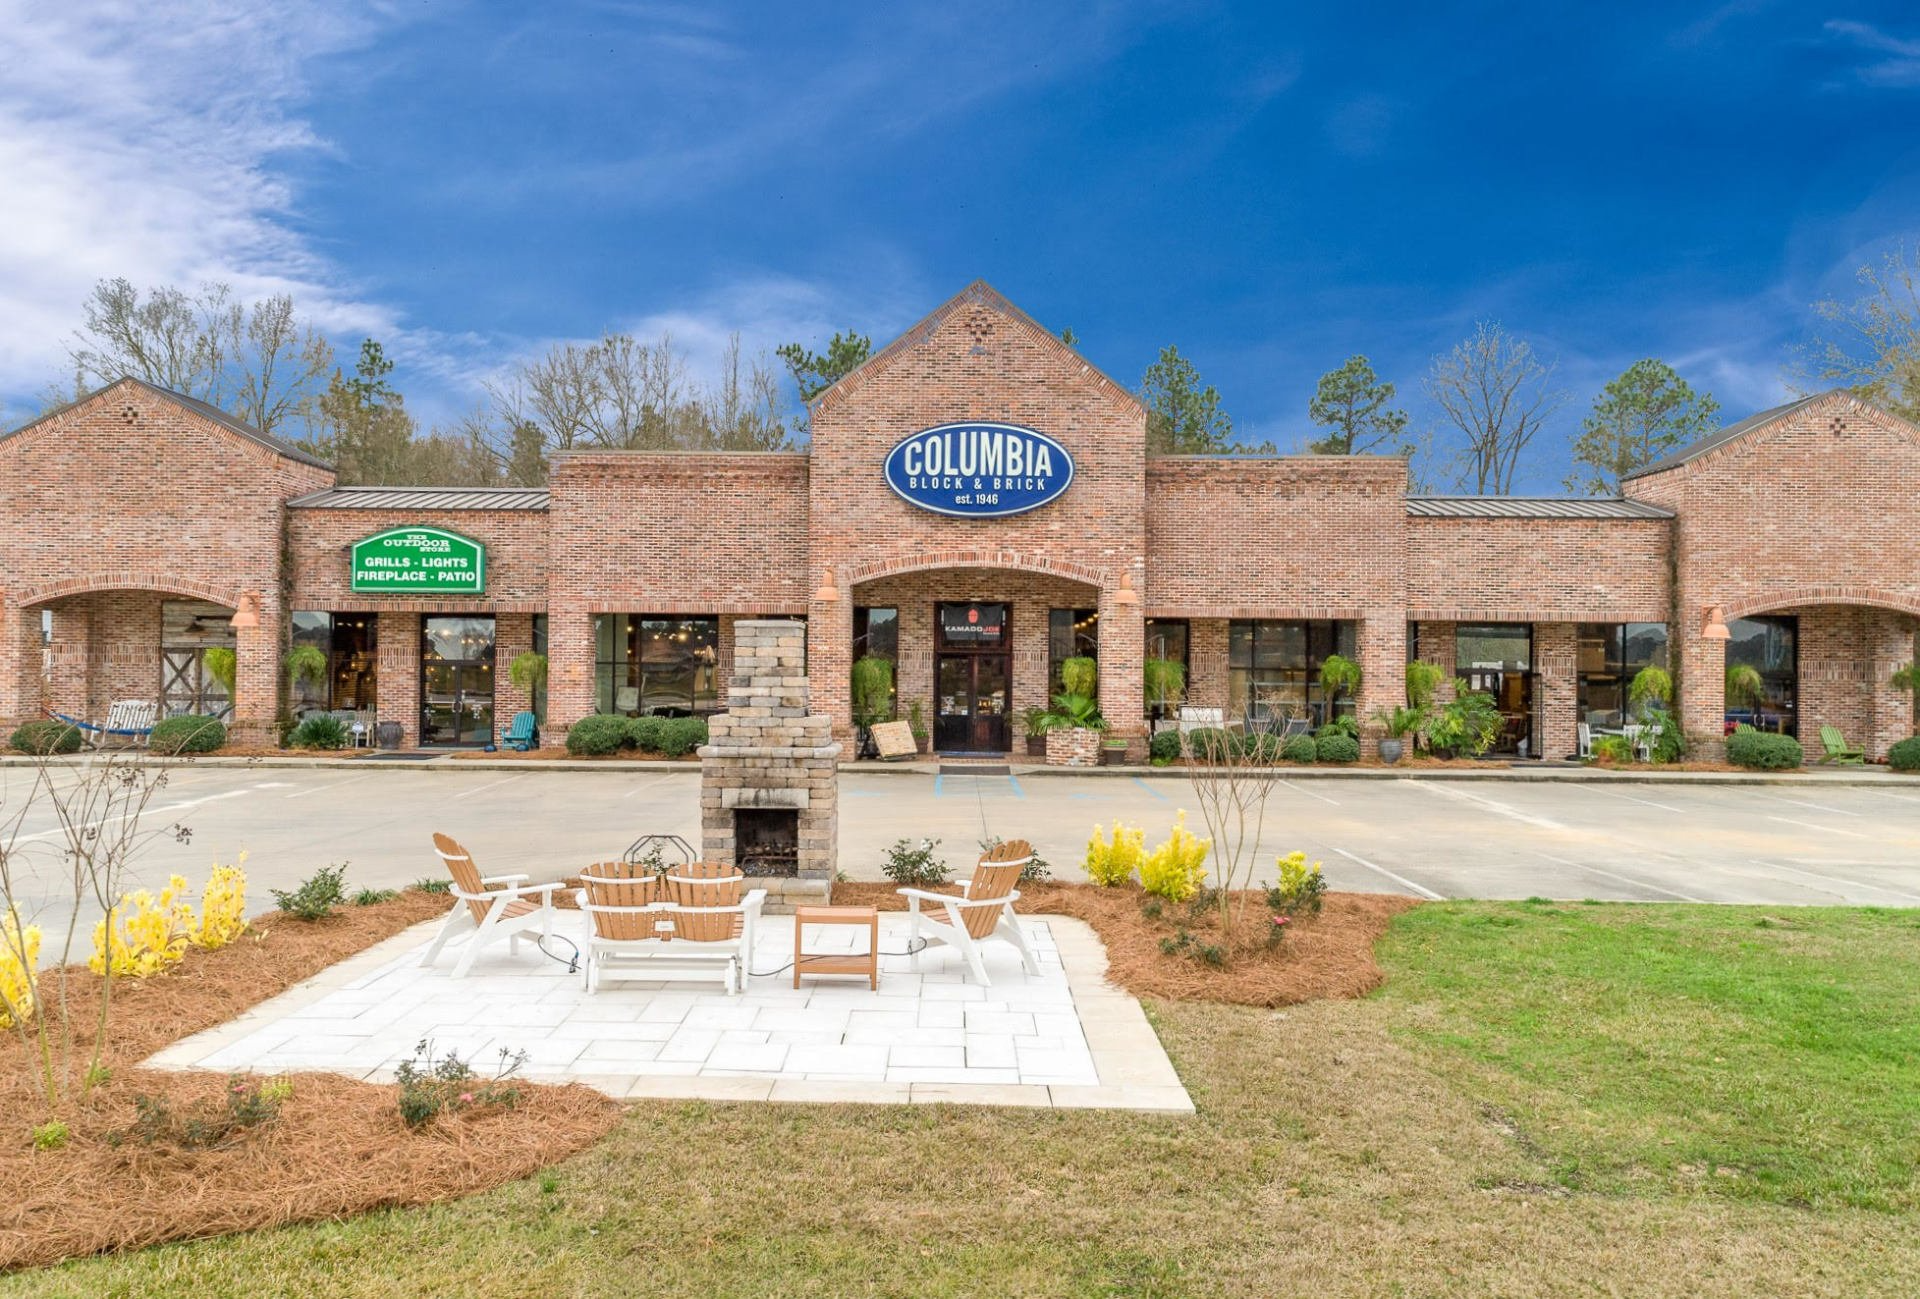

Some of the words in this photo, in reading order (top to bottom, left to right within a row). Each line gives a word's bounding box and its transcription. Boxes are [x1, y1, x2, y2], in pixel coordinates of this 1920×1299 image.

[904, 431, 1053, 477] COLUMBIA
[909, 477, 963, 489] BLOCK
[974, 478, 983, 489] &
[993, 478, 1045, 490] BRICK
[955, 494, 973, 505] est.
[976, 494, 998, 505] 1946
[383, 539, 450, 547] OUTDOOR
[365, 557, 411, 567] GRILLS
[421, 557, 468, 568] LIGHTS
[356, 571, 427, 581] FIREPLACE
[437, 571, 476, 582] PATIO
